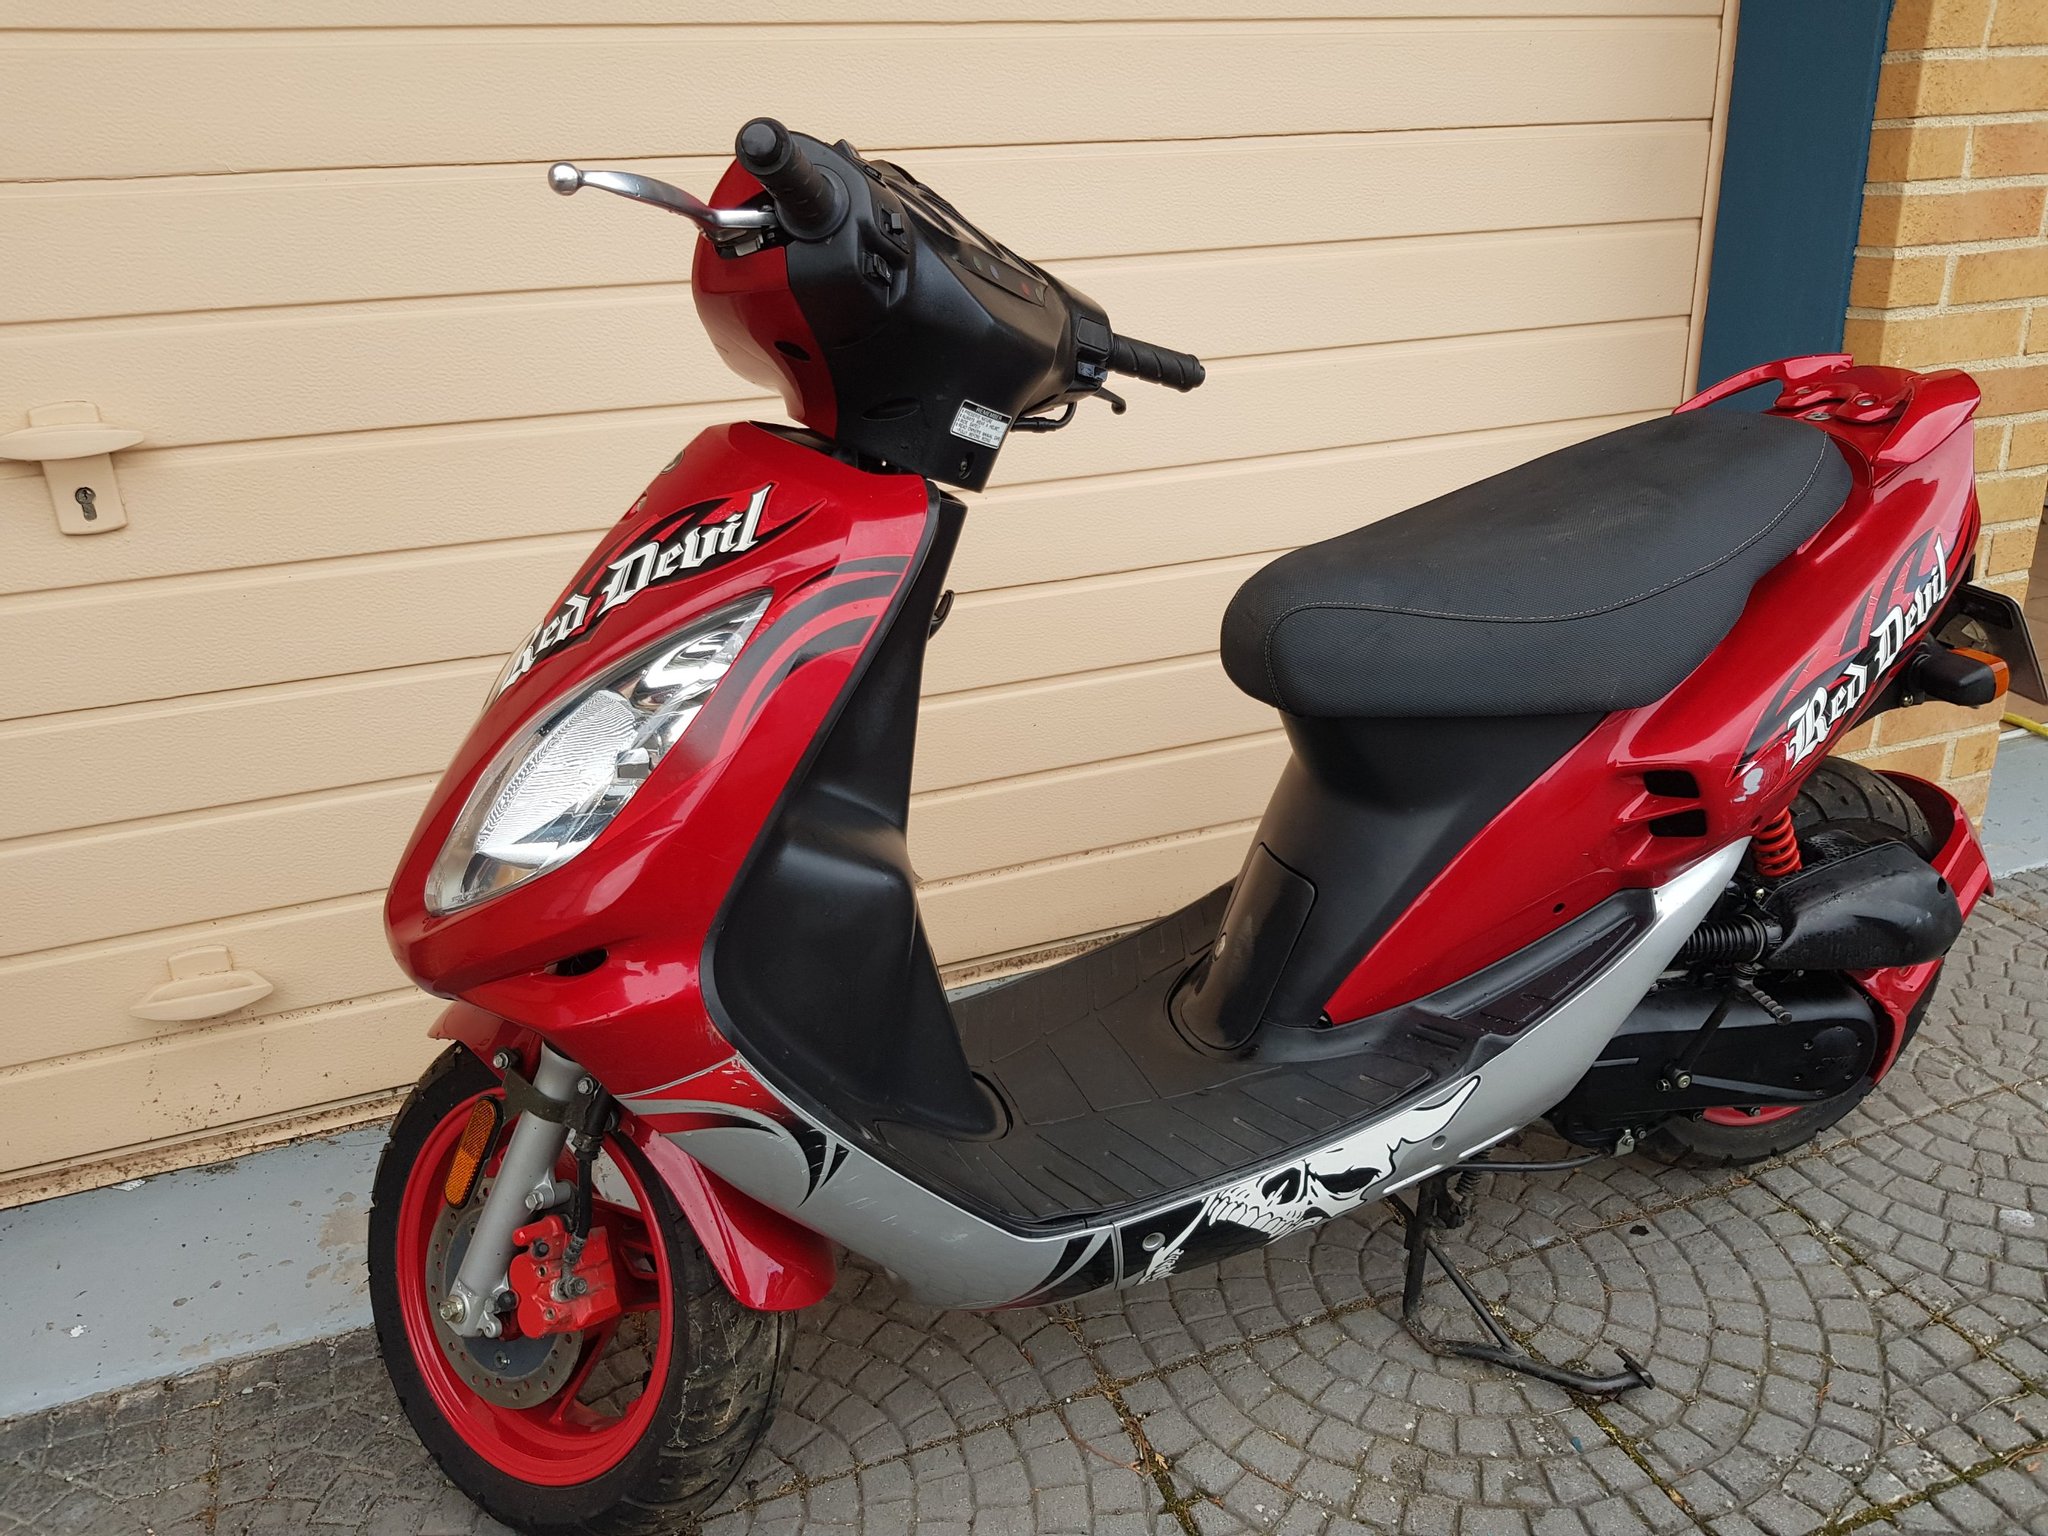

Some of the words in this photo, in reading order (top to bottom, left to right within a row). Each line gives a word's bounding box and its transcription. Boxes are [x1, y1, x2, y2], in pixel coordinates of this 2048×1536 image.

[976, 407, 1002, 420] REMEMBER
[597, 485, 771, 618] Devil
[1787, 664, 1868, 770] Red
[1870, 533, 1949, 682] Devil
